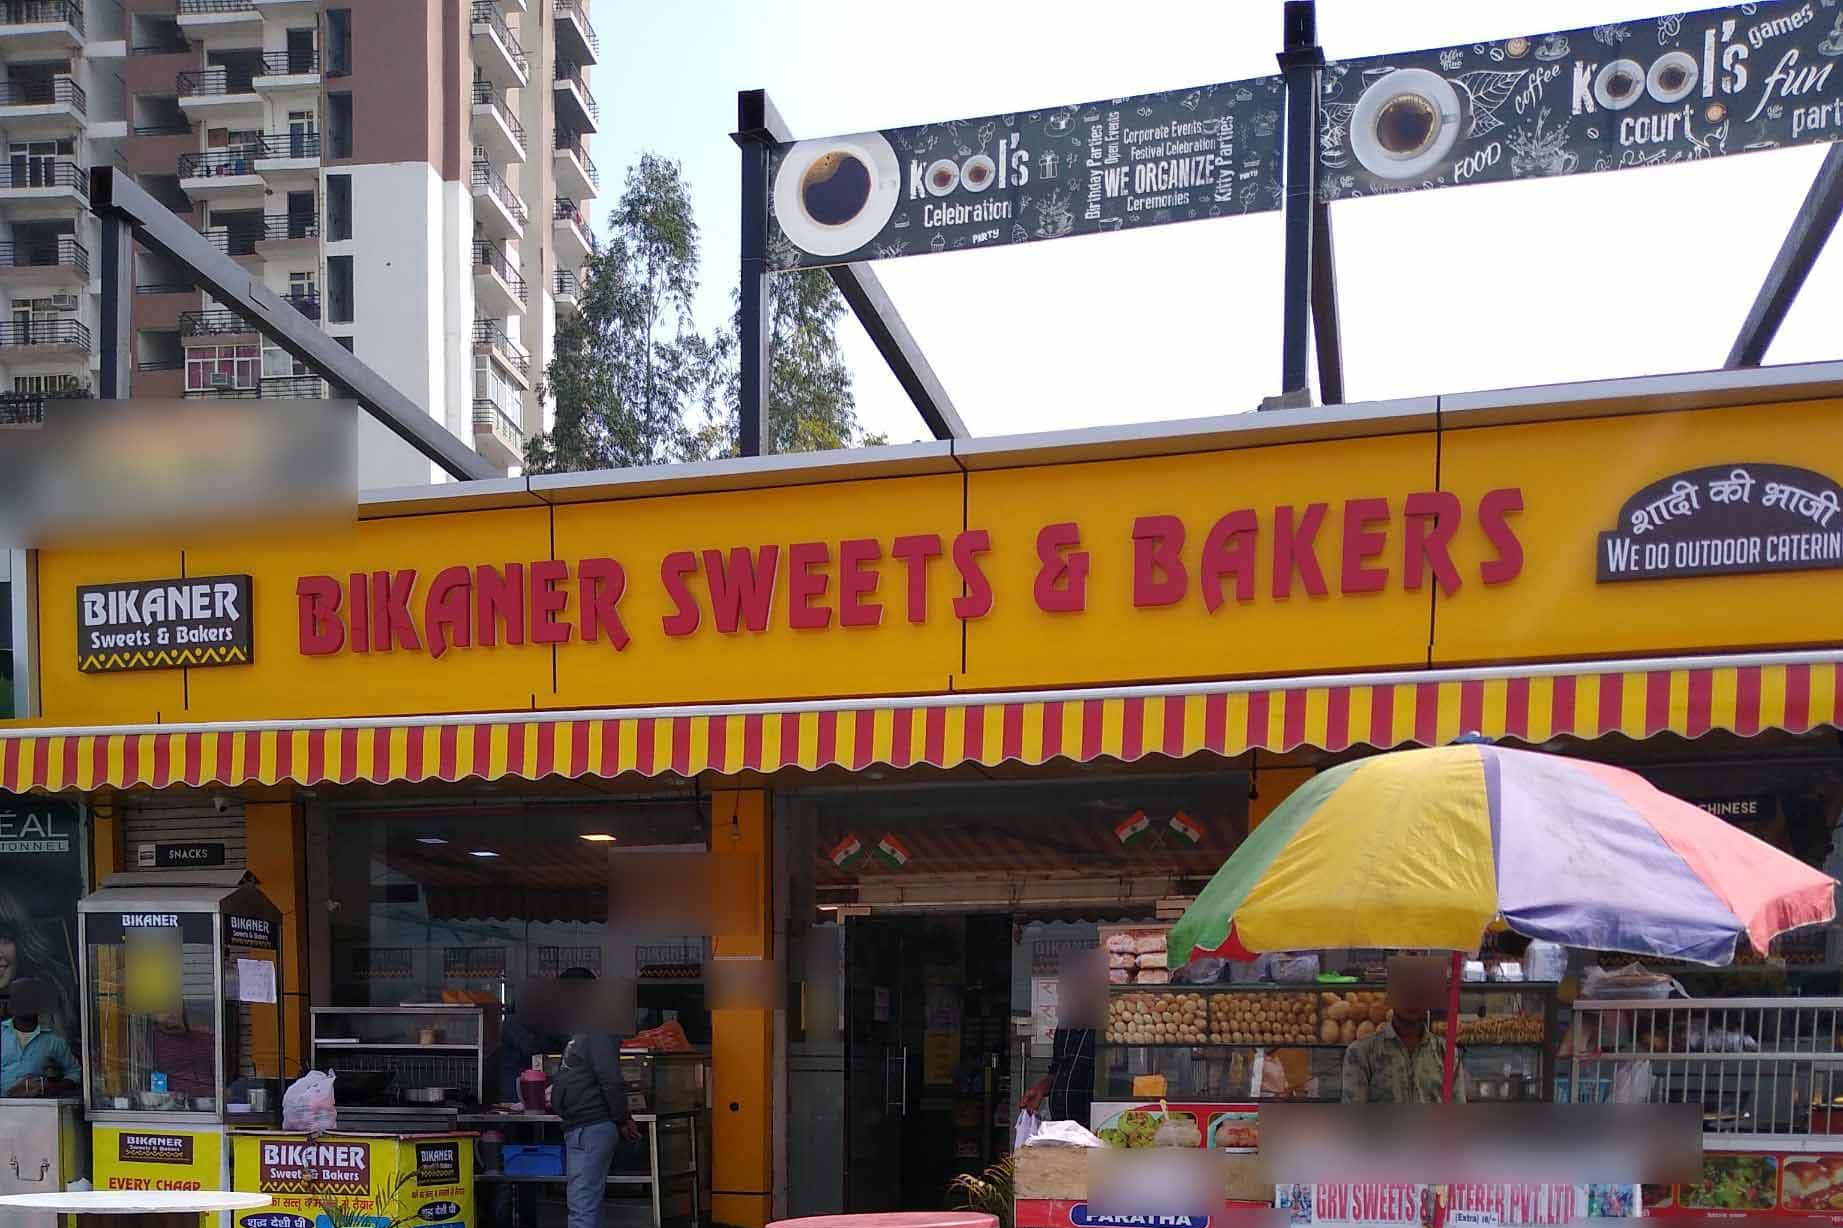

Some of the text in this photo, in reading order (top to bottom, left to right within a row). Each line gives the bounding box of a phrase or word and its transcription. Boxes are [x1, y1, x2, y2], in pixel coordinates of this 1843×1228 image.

[1748, 4, 1813, 49] games
[1745, 49, 1834, 122] fun
[1123, 120, 1202, 144] Corporate Events
[1620, 104, 1694, 146] court
[1792, 98, 1843, 138] part
[1131, 138, 1216, 161] Festival Celebration
[1214, 115, 1235, 202] Kitty Parties
[1454, 142, 1501, 183] FOOD
[1084, 125, 1104, 220] Birthday Parties
[1105, 154, 1215, 198] WE ORGANIZE
[924, 197, 1012, 228] Celebration
[1126, 191, 1190, 212] Ceremonies
[1631, 469, 1841, 535] शादी की भाजी
[1645, 544, 1670, 570] DO
[1675, 537, 1761, 568] OUTDOOR
[1766, 532, 1843, 563] CATERIN
[296, 487, 1525, 661] BIKANER SWEETS & BAKERS
[83, 583, 240, 626] BIKANER
[91, 625, 233, 649] Sweets & Bakers
[169, 849, 208, 860] SNACKS
[122, 914, 179, 927] BIKANER
[231, 917, 270, 934] BIKANER
[127, 1136, 184, 1148] BIKANER
[264, 1144, 366, 1170] BIKANER
[109, 1177, 151, 1190] EVERY
[270, 1168, 304, 1180] Sweet
[322, 1169, 359, 1181] Bakers
[1353, 1184, 1416, 1221] SWEETS
[271, 1217, 291, 1228] देशी
[294, 1218, 306, 1228] घी
